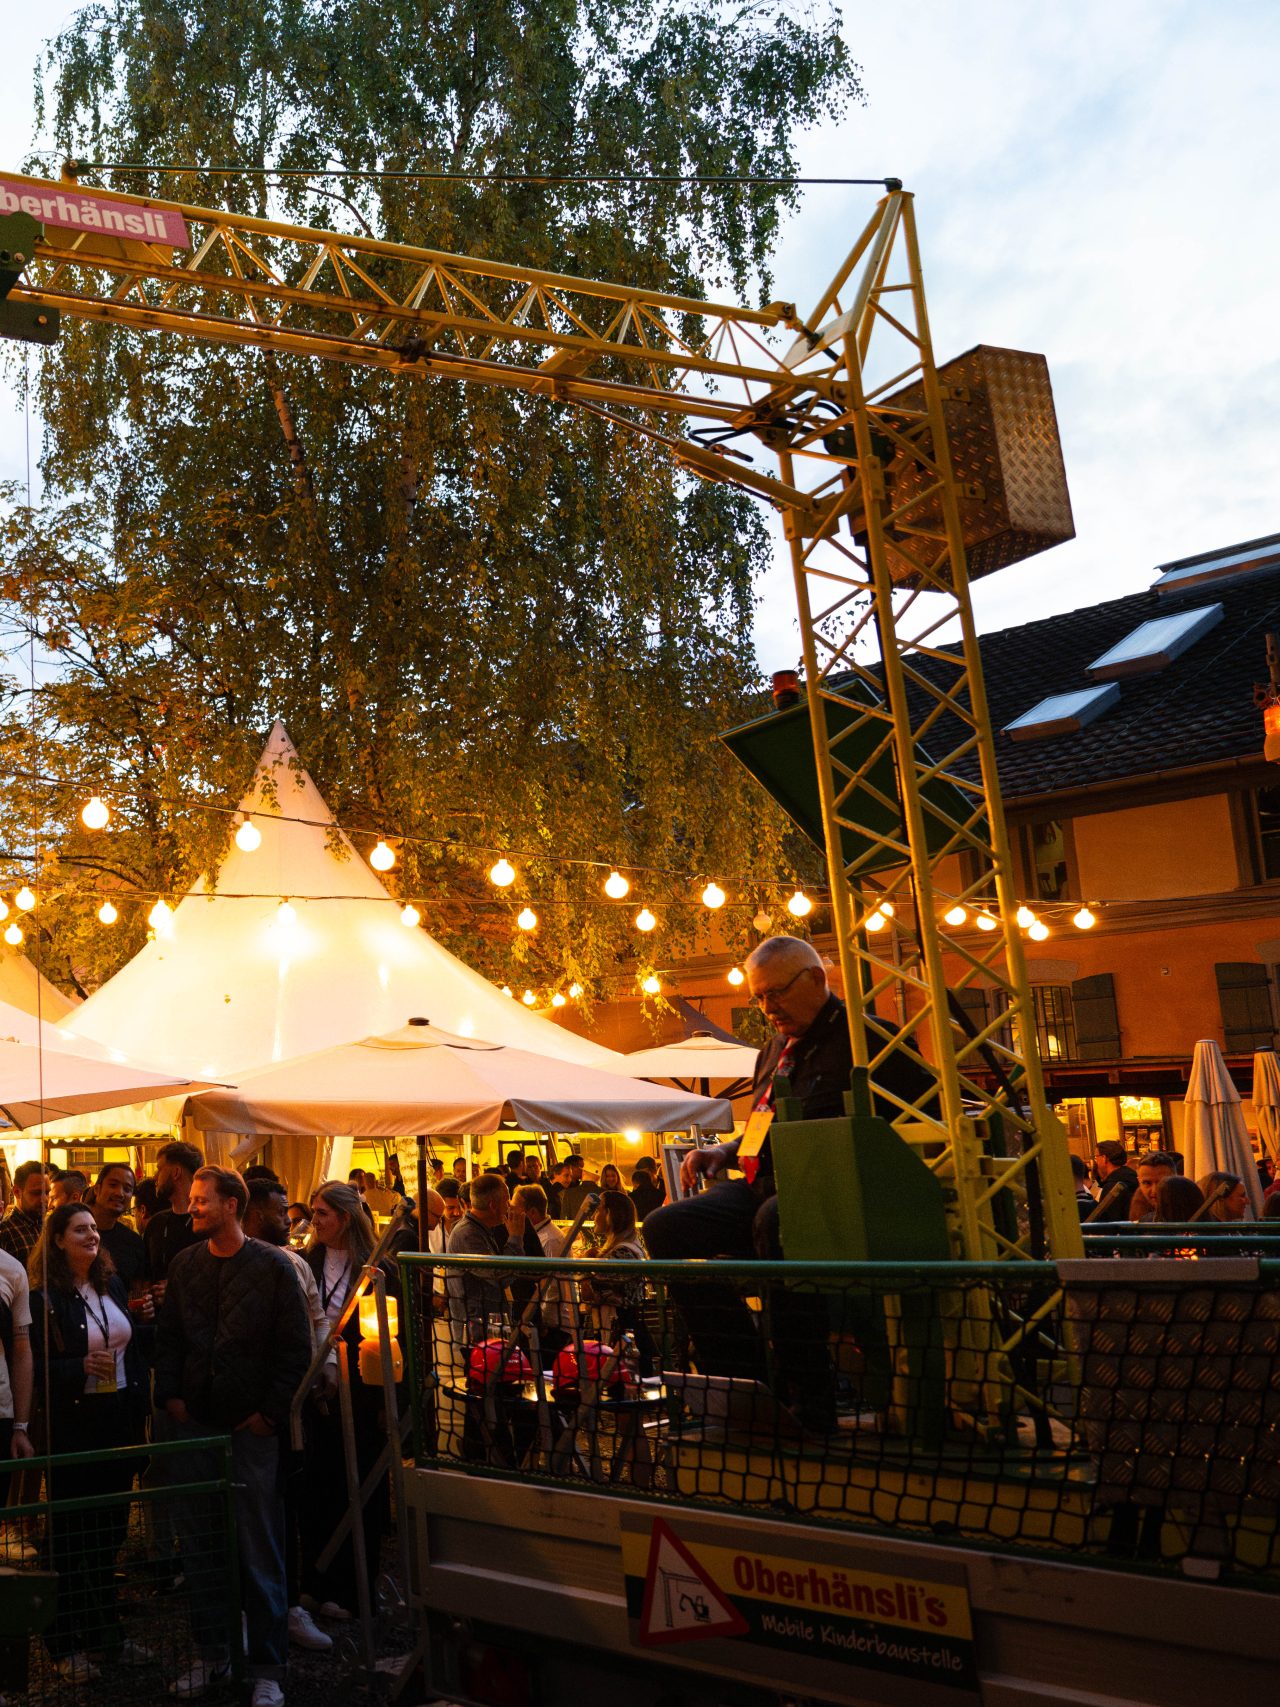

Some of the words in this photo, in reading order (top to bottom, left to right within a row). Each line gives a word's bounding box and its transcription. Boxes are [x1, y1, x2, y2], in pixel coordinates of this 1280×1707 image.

[733, 1555, 948, 1627] Oberhänsli's
[761, 1613, 815, 1641] Mobile
[821, 1627, 963, 1671] Kinderbaustelle
